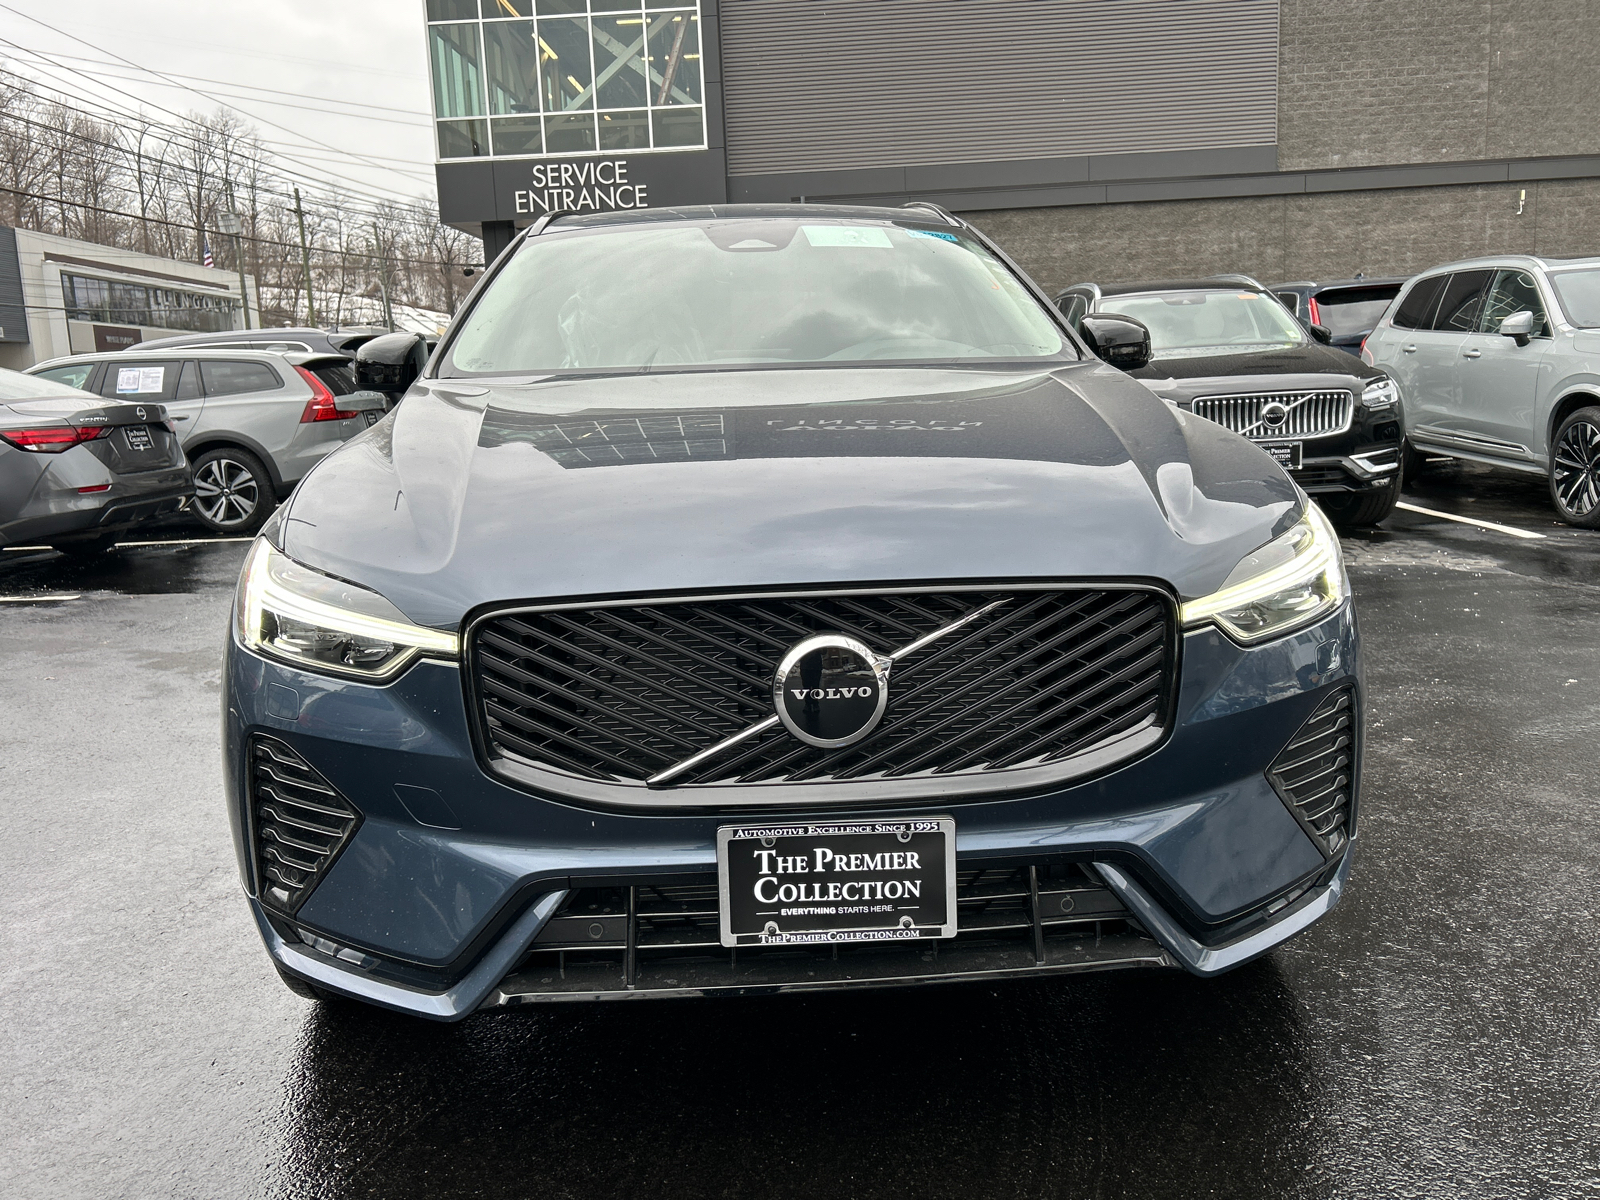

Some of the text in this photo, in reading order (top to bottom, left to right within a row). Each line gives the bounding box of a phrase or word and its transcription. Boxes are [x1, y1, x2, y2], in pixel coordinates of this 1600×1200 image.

[532, 160, 628, 188] SERVICE
[515, 184, 648, 213] ENTRANCE
[791, 686, 872, 700] VOLVO
[735, 822, 938, 838] AUTOMOTIVE EXCELLENCE SINCE 1995
[753, 847, 921, 875] THE PREMIER
[753, 876, 922, 903] COLLECTION
[781, 905, 895, 916] EVERYTHING STARTS HERE.
[758, 929, 920, 944] THEPREMIERCOLLECTION.COM
